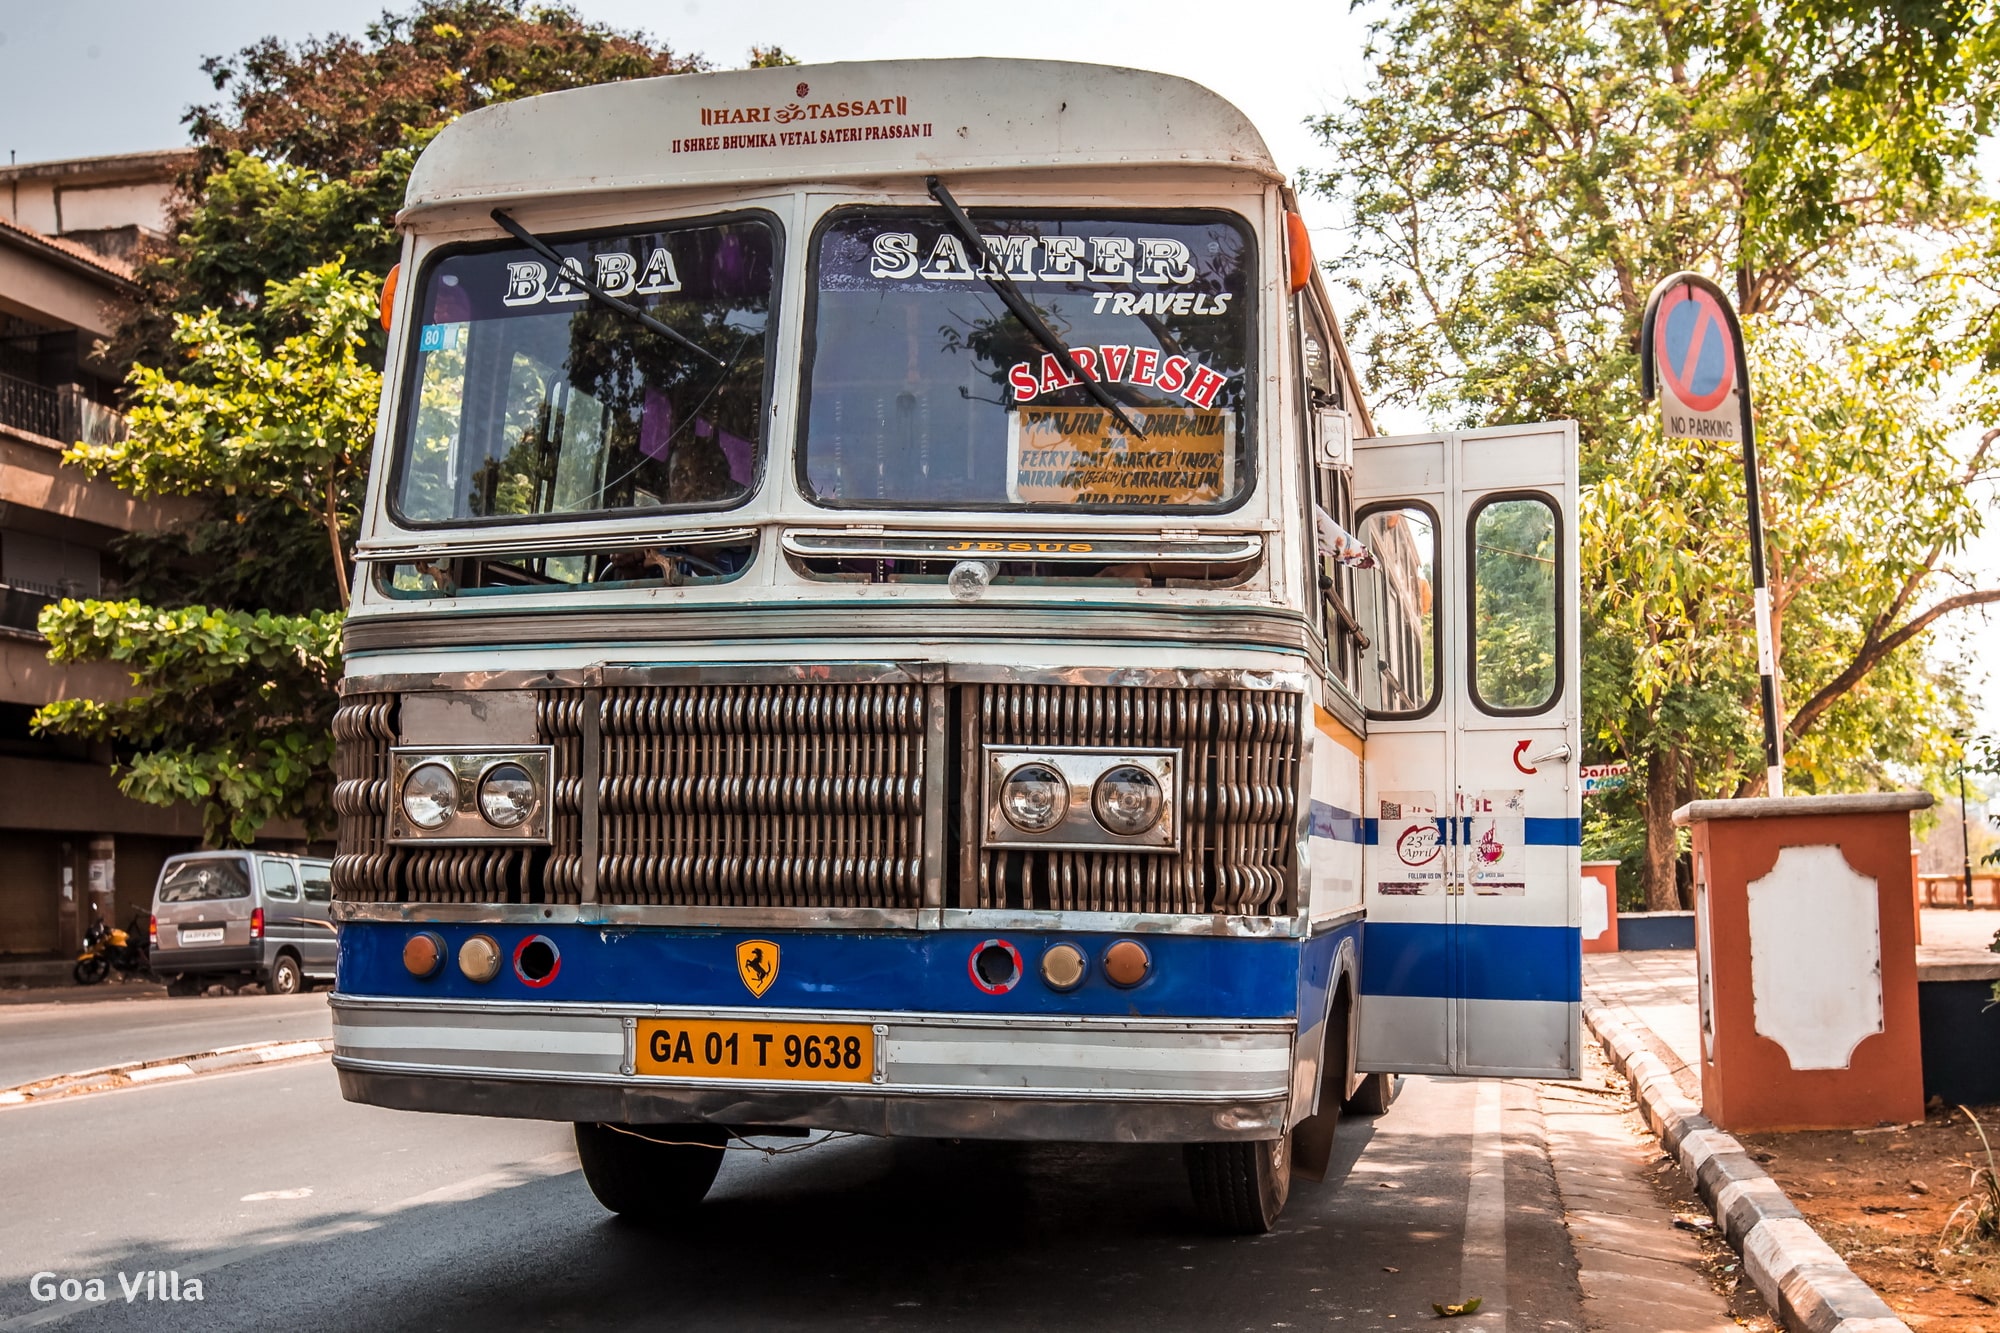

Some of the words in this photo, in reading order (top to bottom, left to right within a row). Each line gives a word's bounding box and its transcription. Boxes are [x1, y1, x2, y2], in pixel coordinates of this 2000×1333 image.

[683, 135, 720, 153] SHREE
[722, 132, 777, 150] BHUMIKA
[779, 129, 818, 147] VETAL
[819, 126, 862, 144] SATERI
[865, 123, 919, 141] PRASSAN
[870, 232, 1196, 285] SAMEER
[503, 247, 682, 307] BABA
[1091, 291, 1233, 316] TRAVELS
[424, 330, 440, 345] 80
[1008, 344, 1227, 411] SARVESH
[1671, 416, 1686, 434] NO
[1689, 418, 1733, 438] PARKING
[1099, 437, 1128, 449] VIA
[1020, 450, 1071, 469] FERRY
[947, 541, 1095, 553] JESUS
[1579, 764, 1629, 778] Casino
[1406, 831, 1434, 848] 23rd
[1402, 847, 1434, 861] April
[650, 1030, 695, 1064] GA
[705, 1032, 739, 1066] 01
[753, 1034, 773, 1067] T
[784, 1035, 862, 1069] 9638
